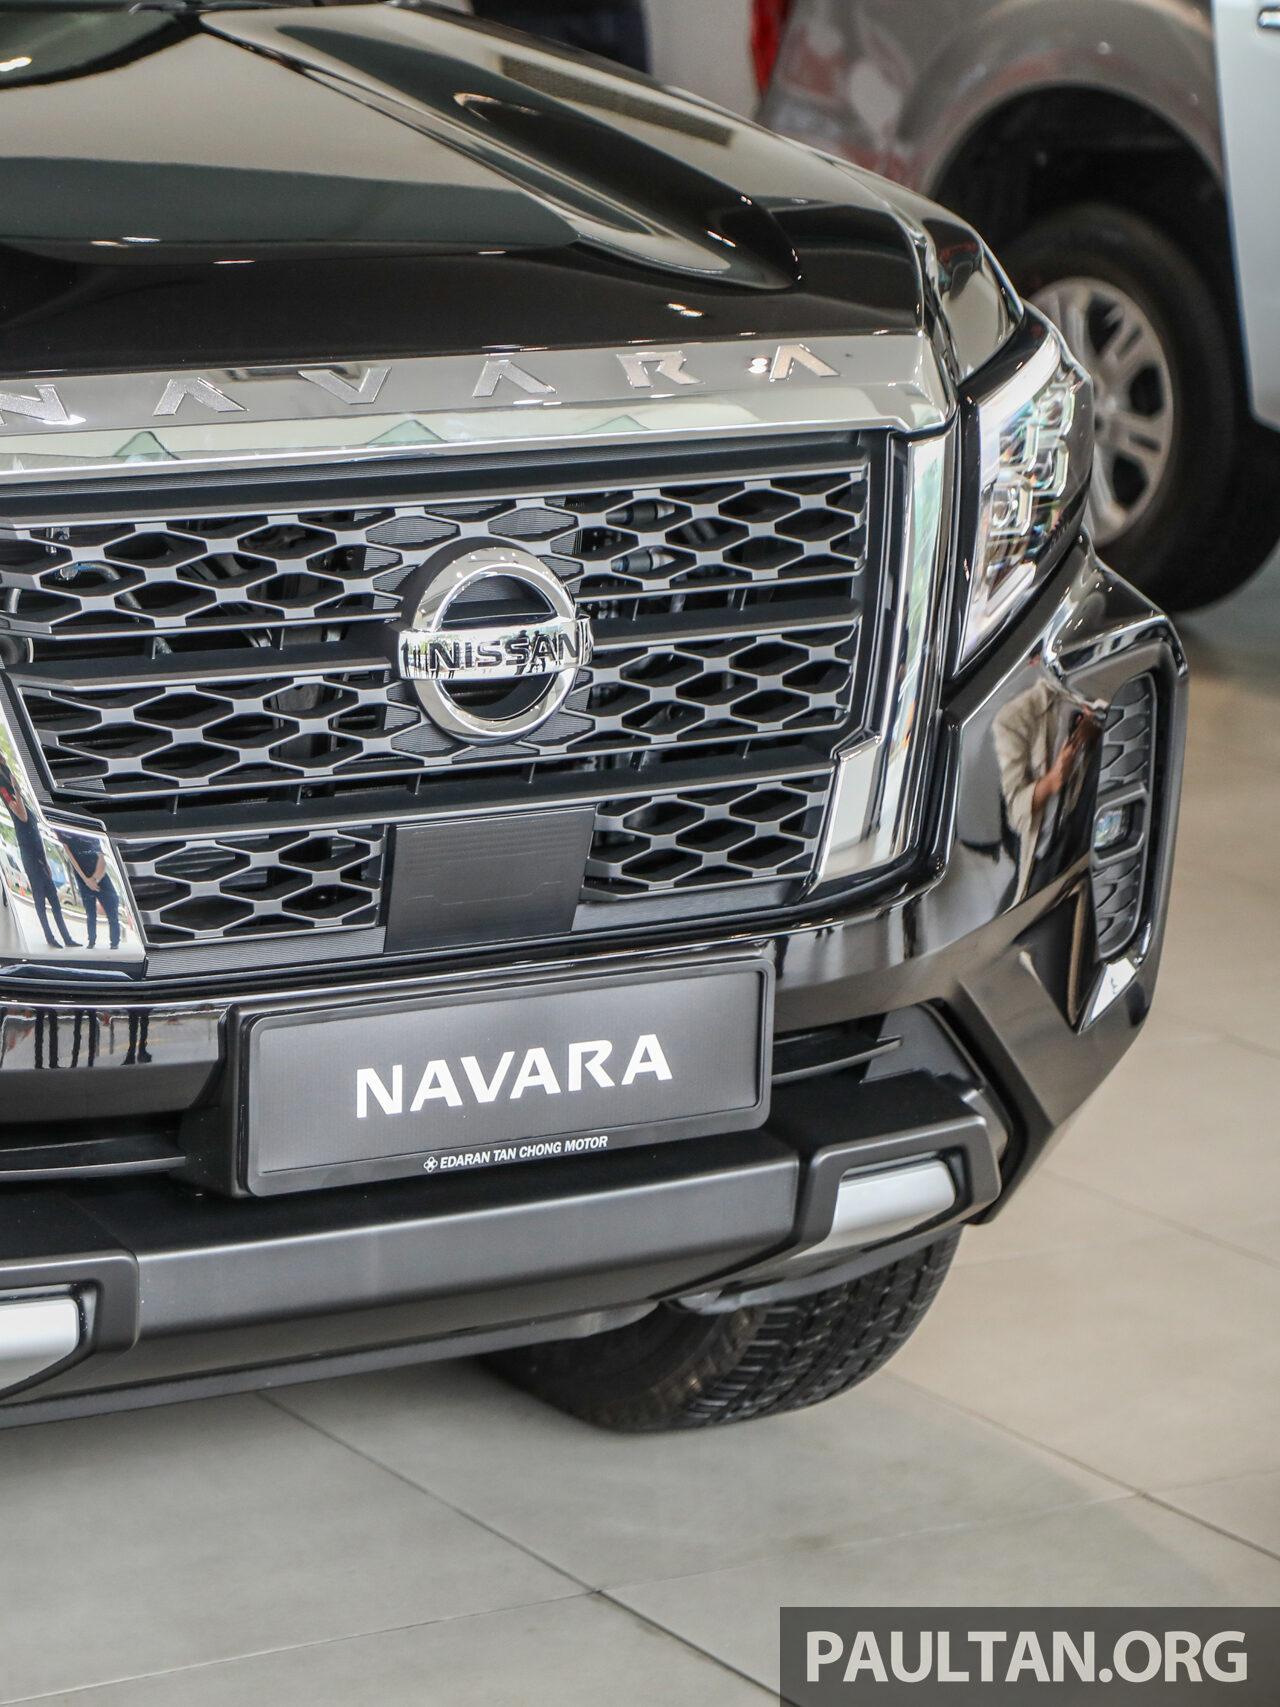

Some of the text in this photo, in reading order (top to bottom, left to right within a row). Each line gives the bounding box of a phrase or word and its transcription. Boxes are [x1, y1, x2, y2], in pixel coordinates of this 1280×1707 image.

[428, 632, 580, 672] NISSAN
[355, 1033, 673, 1120] NAVARA
[439, 1135, 609, 1169] EDARAN TAN CHONG MOTOR
